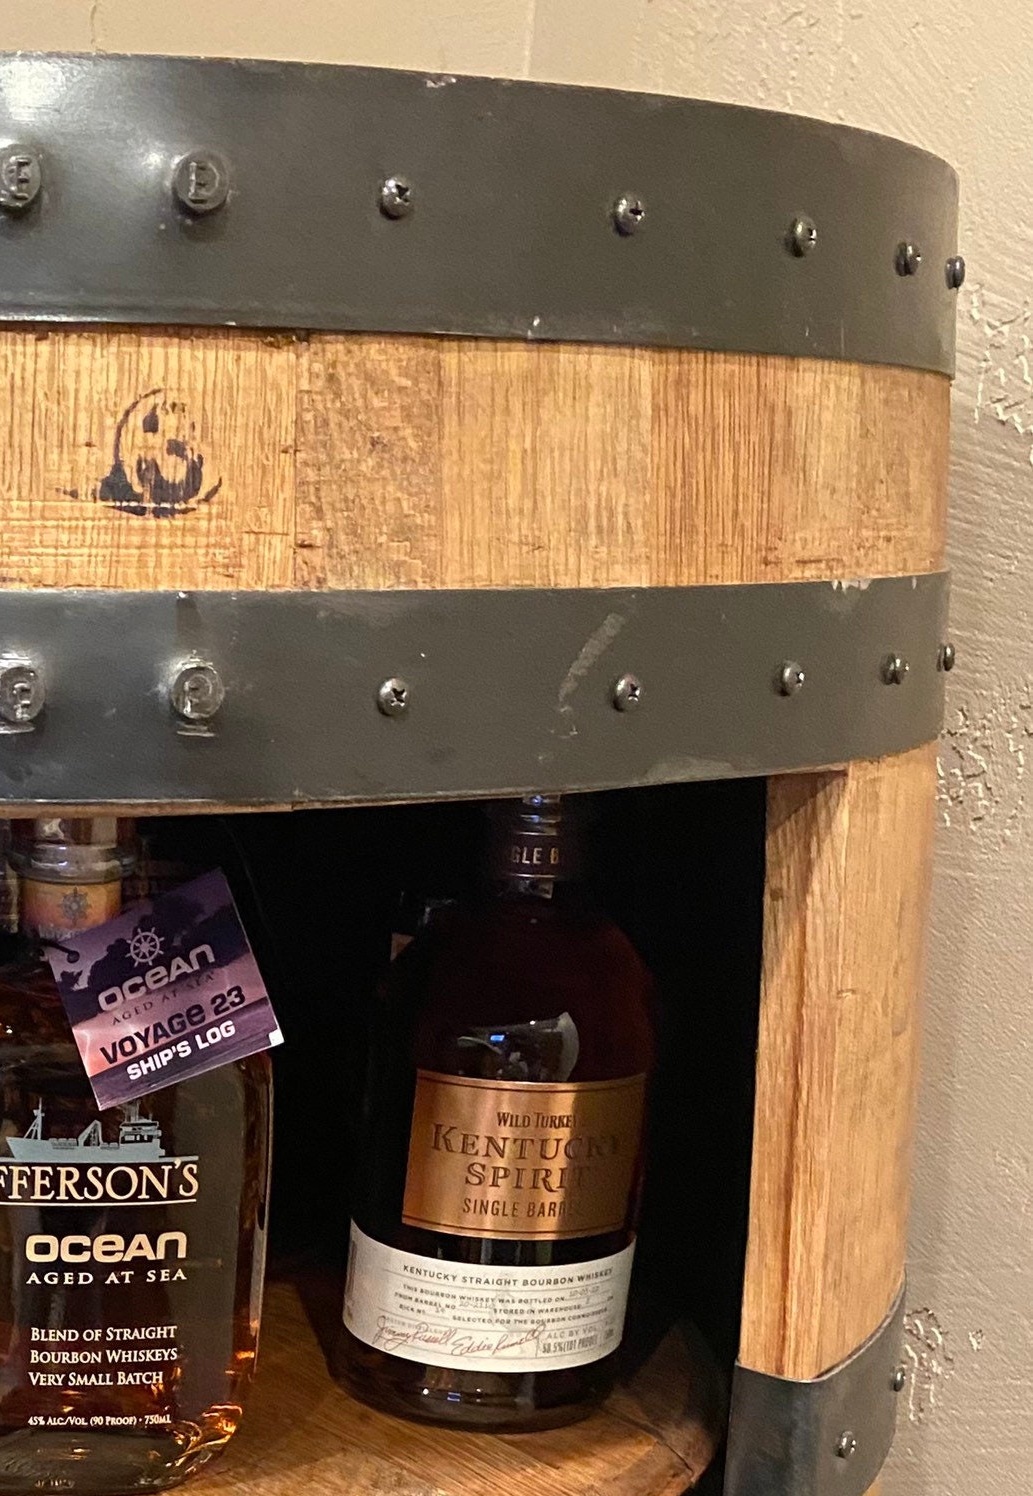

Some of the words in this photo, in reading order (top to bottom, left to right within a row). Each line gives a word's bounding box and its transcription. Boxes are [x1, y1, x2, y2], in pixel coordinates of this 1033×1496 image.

[111, 1001, 154, 1026] AGED
[161, 988, 179, 1002] AT
[209, 984, 247, 1017] 23
[126, 1040, 193, 1081] SHIP'S
[195, 1019, 237, 1051] LOG
[496, 1111, 531, 1128] WILD
[462, 1197, 519, 1218] SINGLE
[25, 1271, 94, 1286] AGED
[104, 1270, 135, 1285] AT
[145, 1268, 188, 1283] SEA
[403, 1264, 458, 1282] KENTUCKY
[461, 1275, 519, 1287] STRAIGHT
[522, 1276, 574, 1287] BOURBON
[576, 1267, 613, 1282] WHISKEY
[403, 1283, 418, 1293] THIS
[419, 1288, 457, 1300] BOURBON
[458, 1295, 496, 1303] WHISKEY
[394, 1291, 413, 1302] FROM
[414, 1297, 443, 1308] BARREL
[493, 1307, 526, 1315] STORED
[537, 1304, 583, 1315] WAREHOUSE
[452, 1314, 493, 1324] SELECTED
[530, 1316, 567, 1324] BOURBON
[30, 1326, 79, 1342] BLEND
[82, 1328, 103, 1342] OF
[105, 1325, 179, 1341] STRAIGHT
[29, 1349, 103, 1365] BOURBON
[105, 1347, 179, 1364] WHISKEYS
[27, 1371, 67, 1387] VERY
[68, 1371, 114, 1387] SMALL
[116, 1371, 164, 1386] BATCH
[27, 1416, 46, 1427] 45%
[89, 1415, 104, 1428] (90
[104, 1415, 138, 1427] PROOF)
